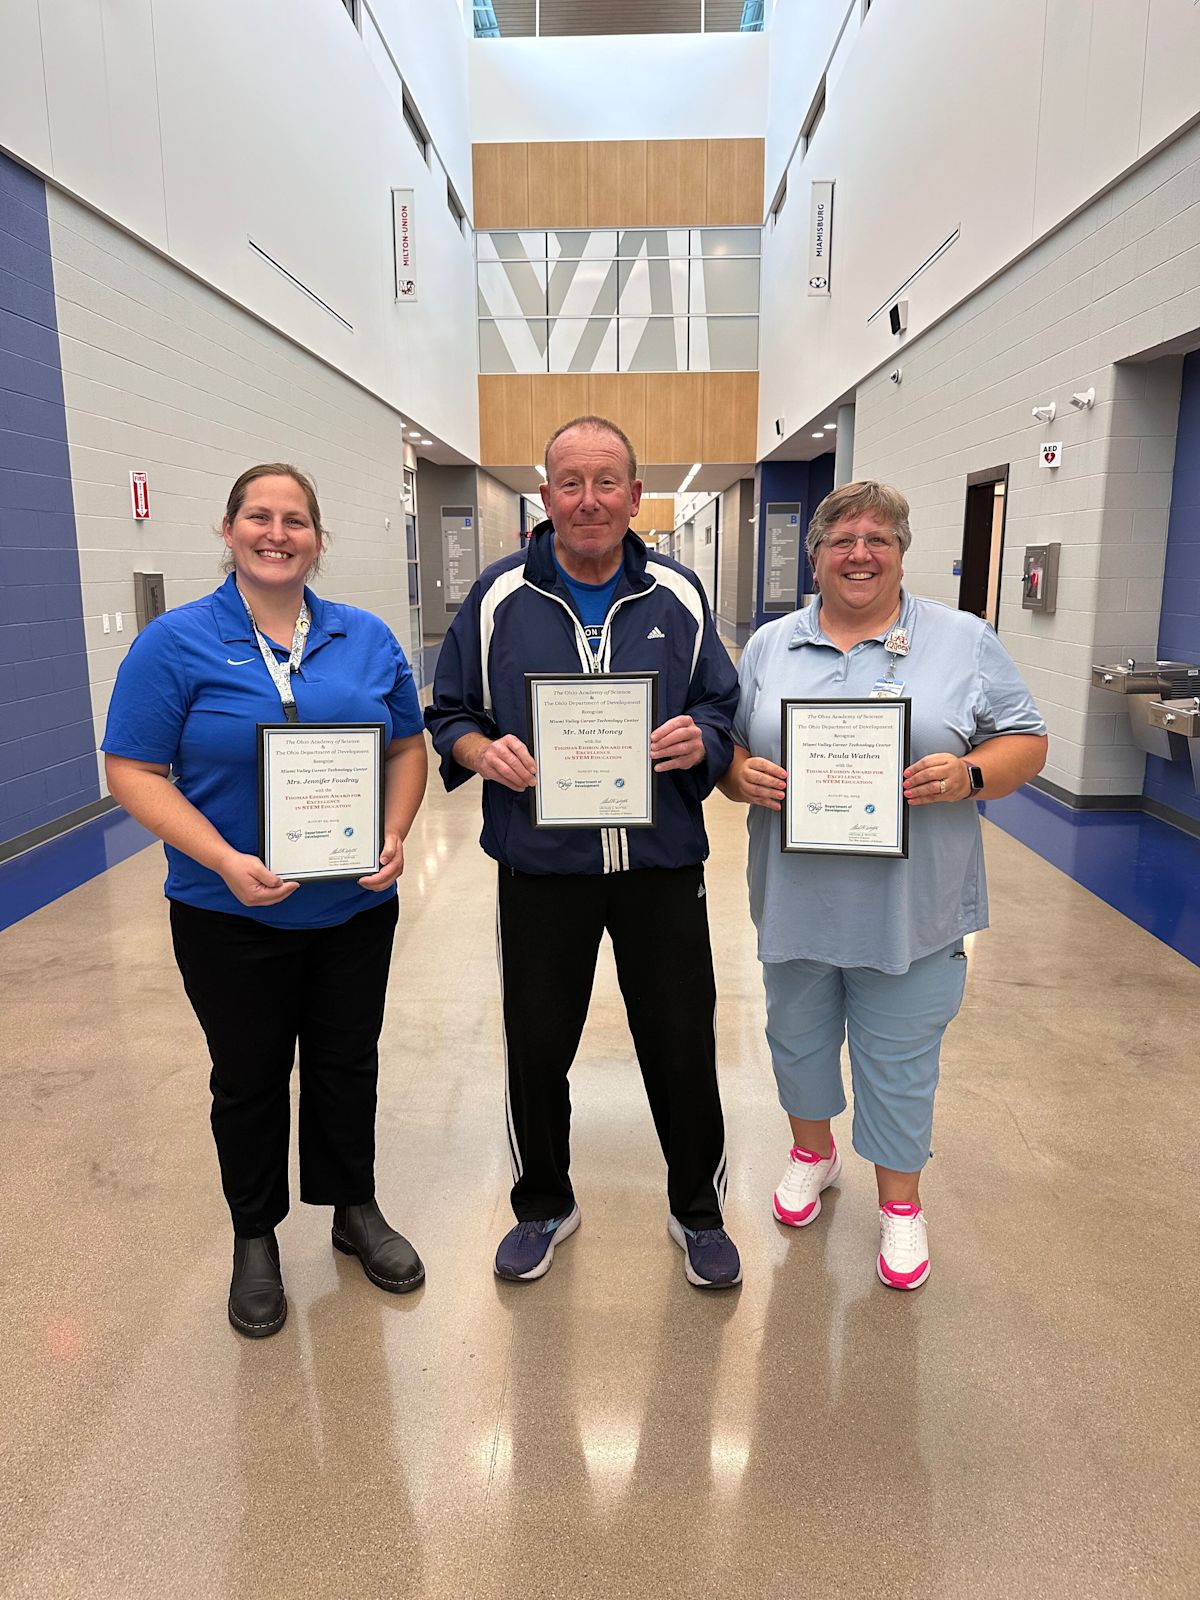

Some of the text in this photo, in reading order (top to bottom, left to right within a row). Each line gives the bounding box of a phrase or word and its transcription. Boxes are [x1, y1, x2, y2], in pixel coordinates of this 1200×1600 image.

[401, 205, 409, 266] MILTON-UNION
[816, 204, 824, 257] MIAMISBURG
[791, 515, 797, 524] B
